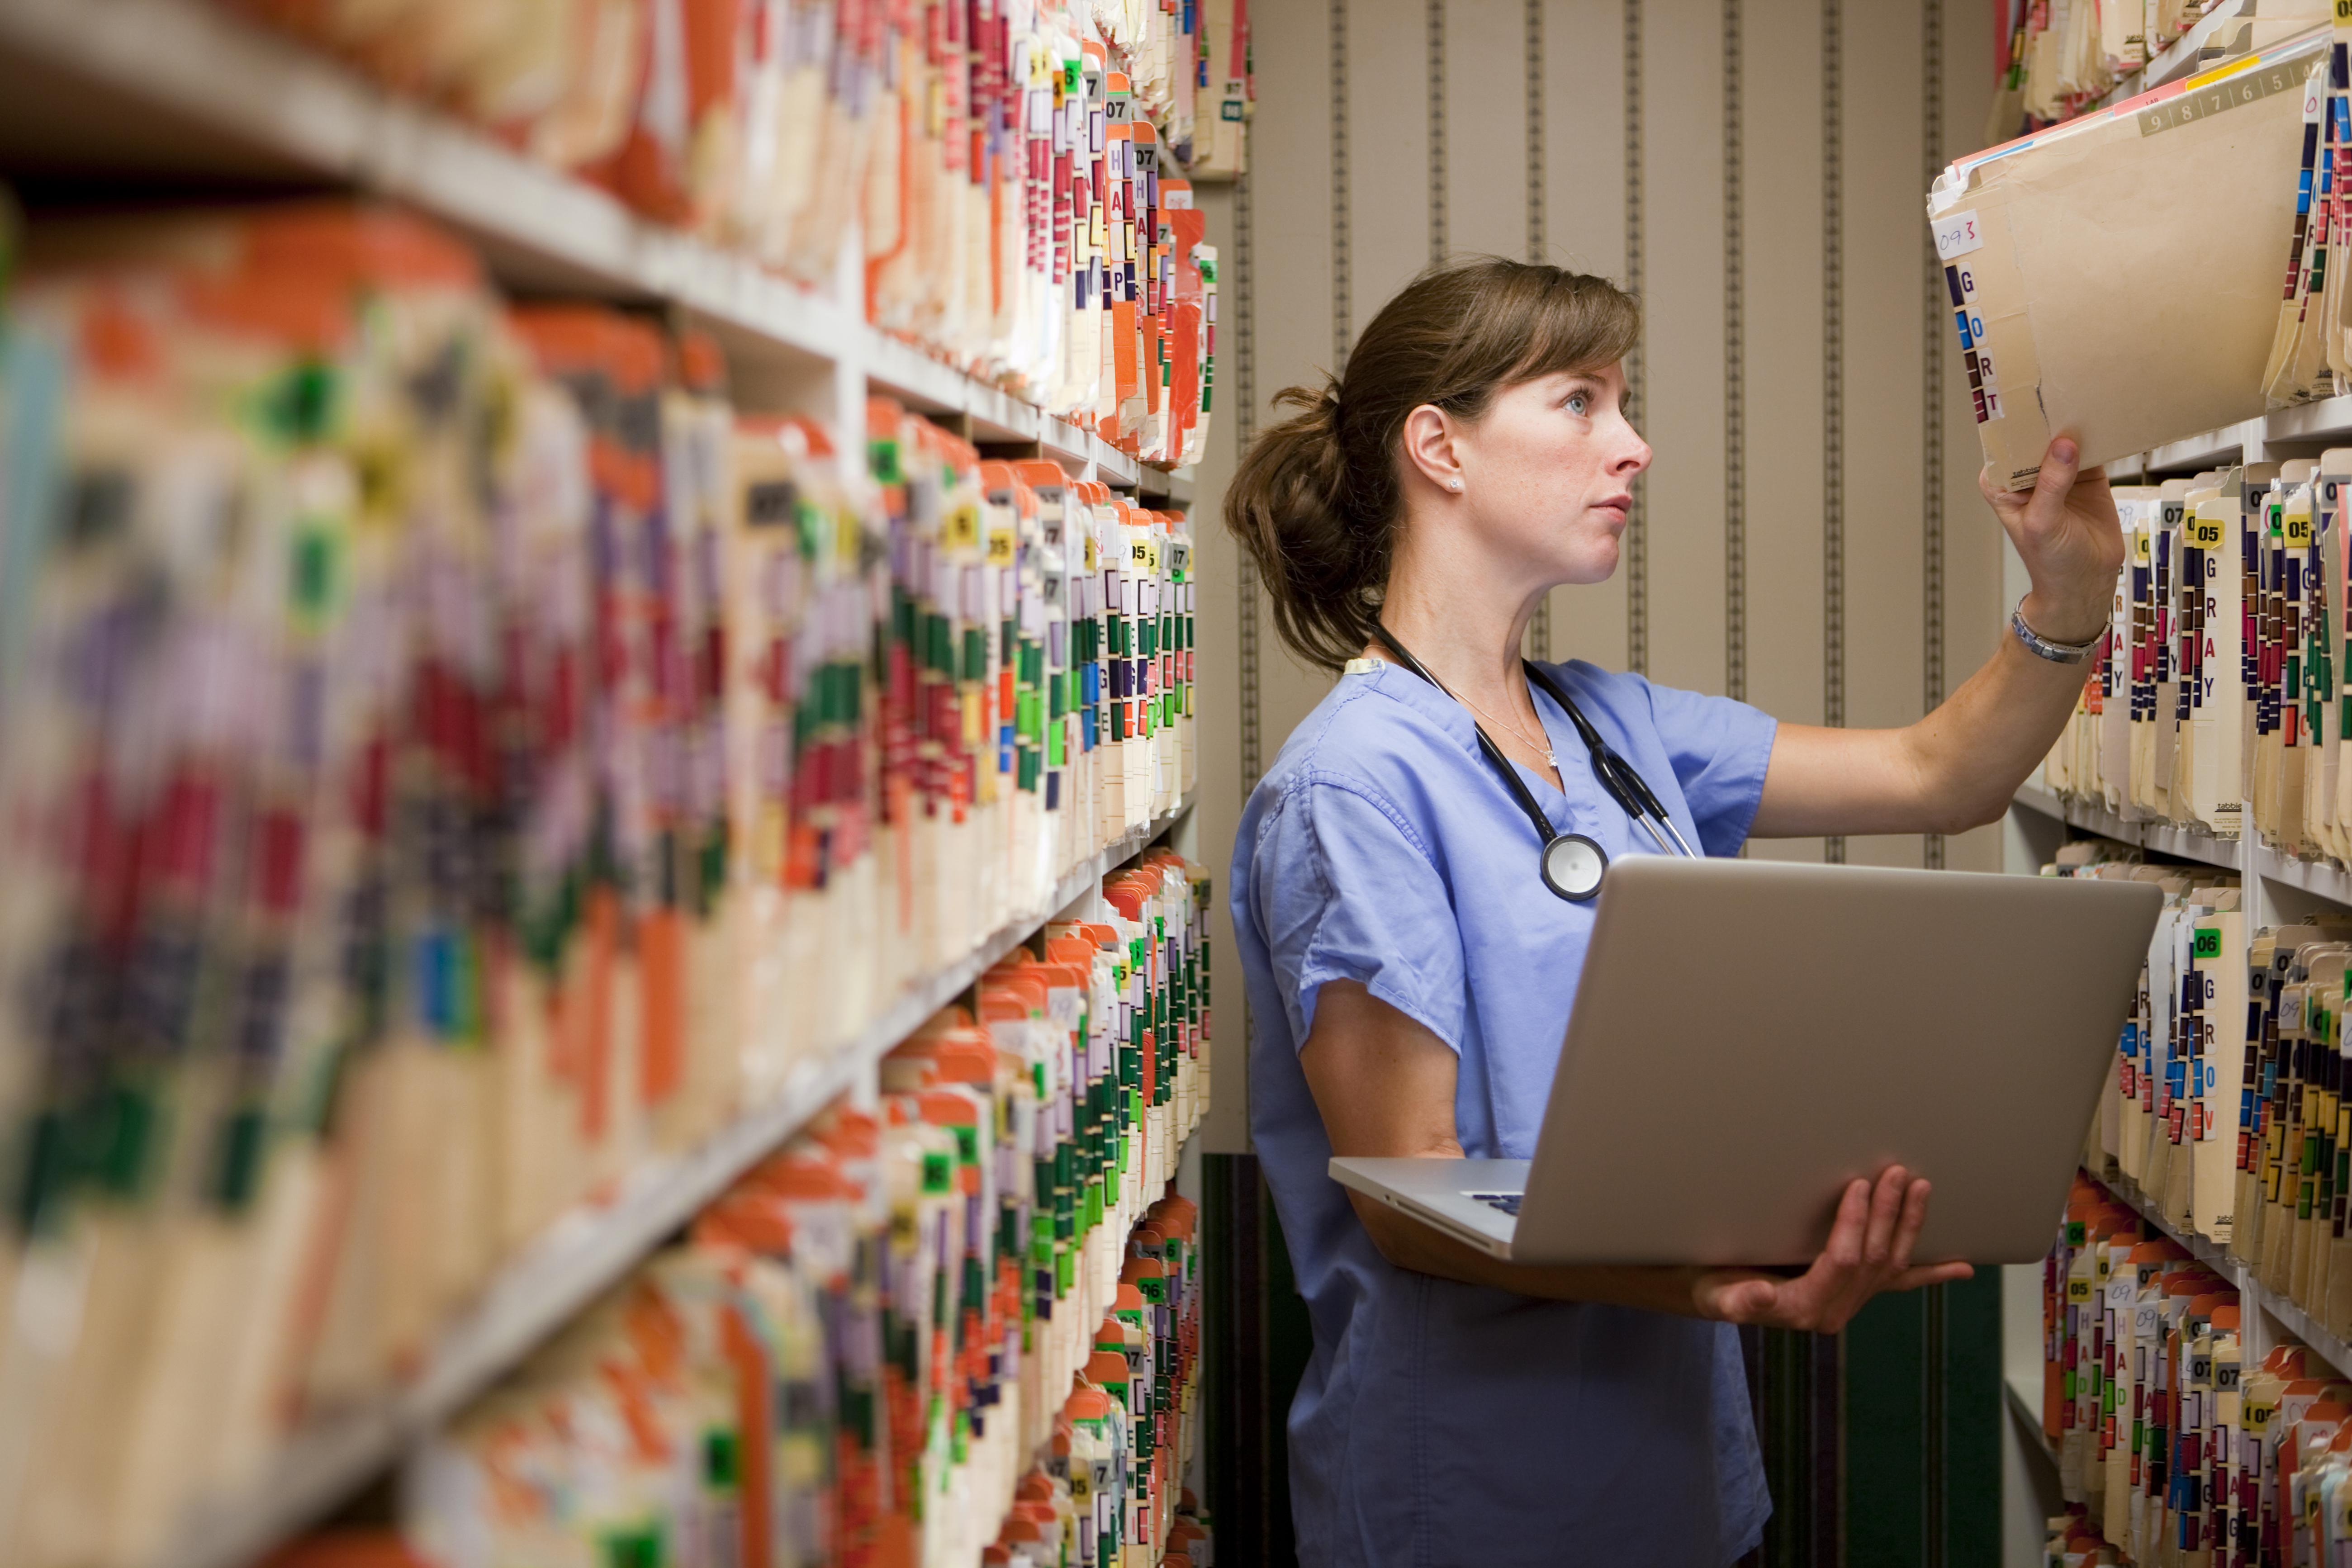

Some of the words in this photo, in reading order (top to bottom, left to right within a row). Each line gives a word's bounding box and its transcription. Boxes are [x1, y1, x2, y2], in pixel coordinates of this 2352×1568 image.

[1065, 67, 1074, 85] 6
[1086, 79, 1097, 96] 7
[1106, 102, 1125, 118] 07
[2146, 98, 2158, 106] LAB
[2151, 116, 2161, 130] 9
[2182, 105, 2192, 120] 8
[2211, 95, 2220, 110] 7
[2242, 85, 2252, 100] 6
[2272, 75, 2282, 90] 5
[1137, 150, 1154, 165] 07
[1159, 229, 1167, 240] 7
[1961, 271, 1997, 411] GORT
[2198, 526, 2218, 541] 05
[2204, 557, 2216, 697] GRAY
[2197, 936, 2217, 952] 06
[2205, 979, 2214, 1130] GROV
[1167, 1243, 1175, 1257] 6
[2071, 1283, 2087, 1295] 05
[2112, 1284, 2131, 1301] 09
[2136, 1309, 2156, 1328] 09
[2117, 1317, 2127, 1441] HADL
[2219, 1369, 2239, 1385] 07
[1095, 1467, 1107, 1484] 7
